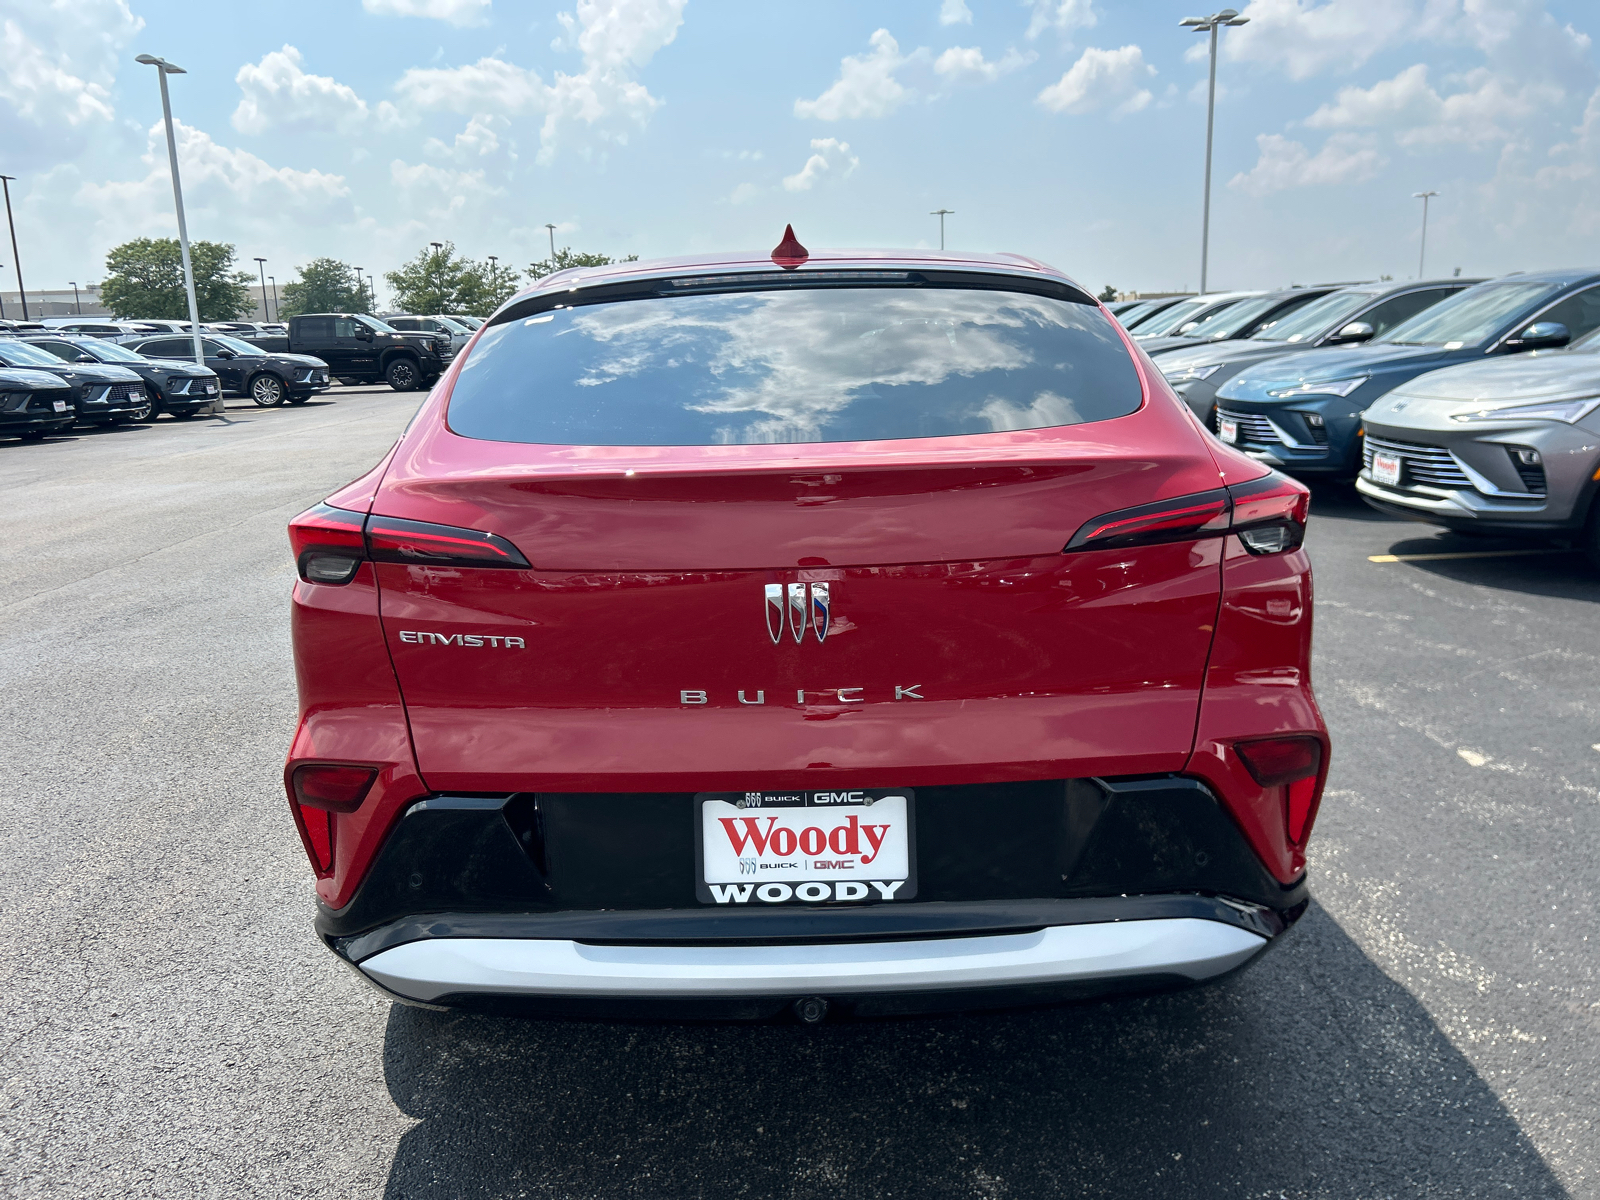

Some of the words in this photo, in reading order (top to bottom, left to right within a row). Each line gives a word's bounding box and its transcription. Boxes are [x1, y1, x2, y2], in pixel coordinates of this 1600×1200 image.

[399, 630, 526, 649] ENVISTA
[680, 684, 924, 704] BUICK
[813, 791, 864, 804] GMC
[717, 815, 891, 865] Woody
[759, 862, 798, 870] BUICK
[813, 859, 855, 870] GMC
[708, 880, 905, 904] WOODY
